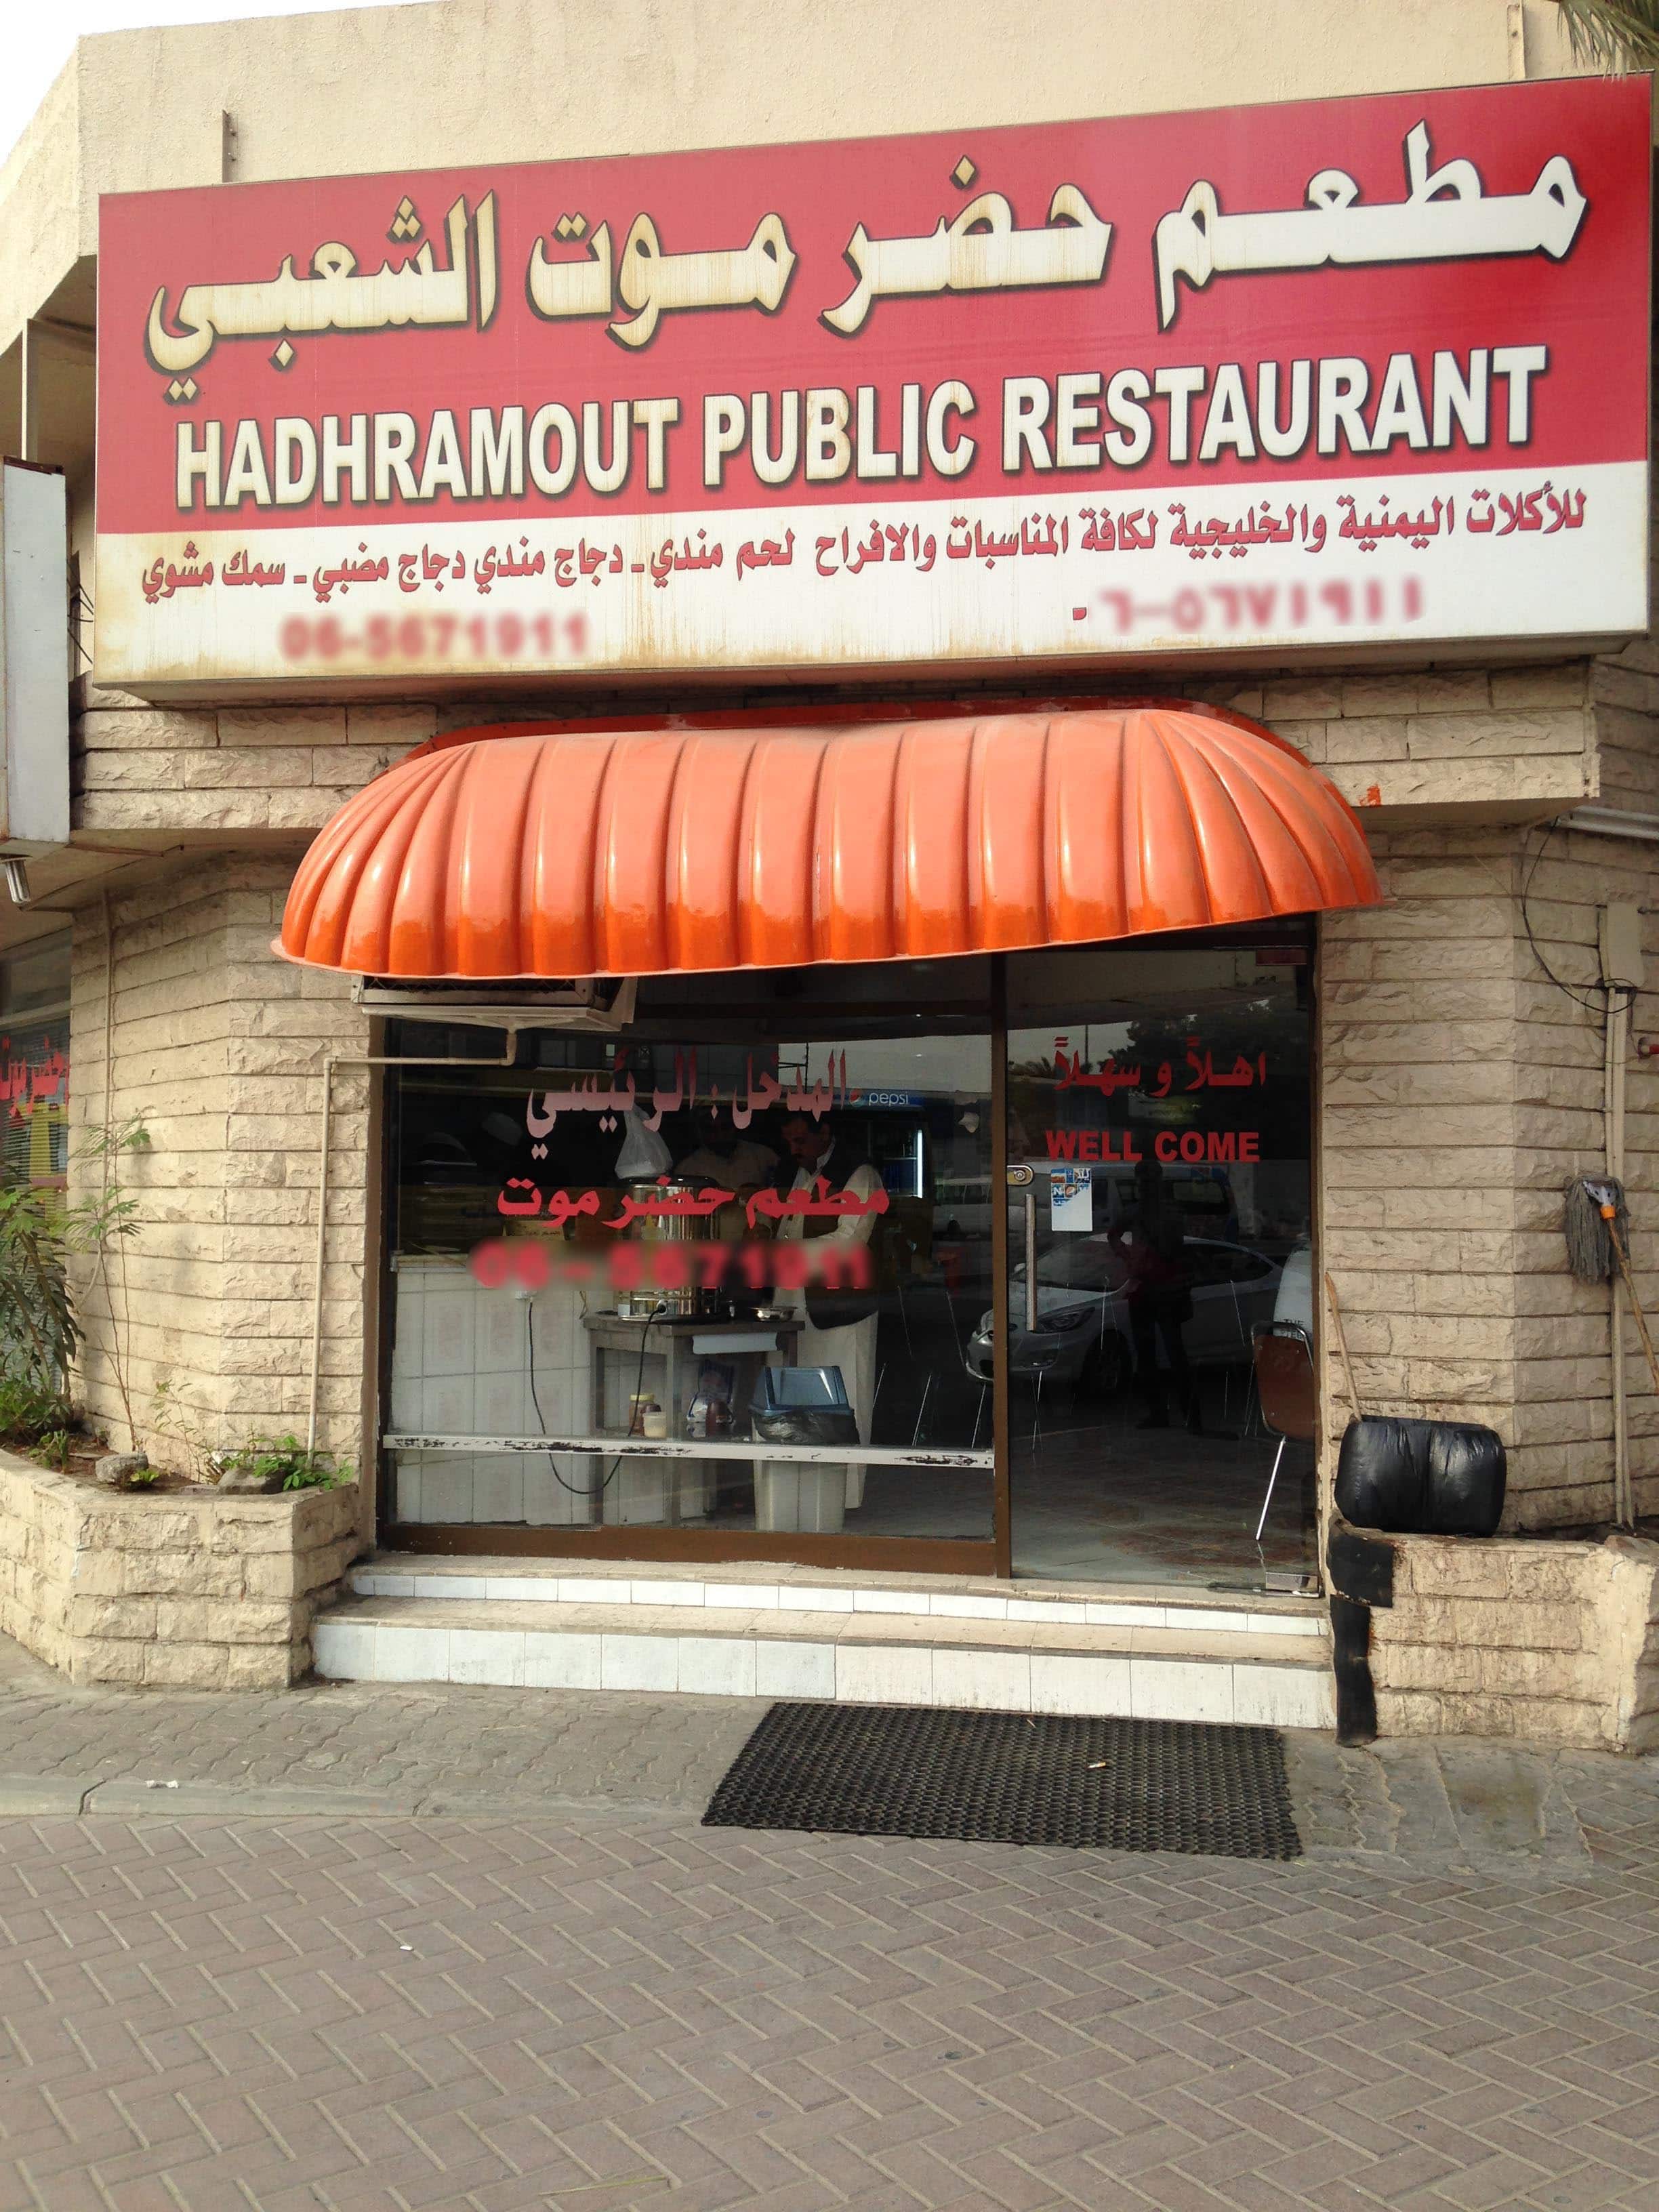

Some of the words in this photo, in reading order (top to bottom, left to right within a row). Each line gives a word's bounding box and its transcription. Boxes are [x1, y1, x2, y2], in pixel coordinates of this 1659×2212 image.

[1158, 119, 1587, 329] مطعم
[146, 189, 495, 401] الشعبي
[175, 396, 680, 510] HADHRAMOUT
[703, 380, 976, 487] PUBLIC
[1003, 345, 1548, 470] RESTAURANT
[1080, 509, 1158, 552] لكافة
[1169, 503, 1326, 559] والخليجية
[1338, 496, 1454, 552] اليمنية
[1467, 485, 1586, 535] للأكلات
[474, 537, 545, 594] مندي
[555, 541, 623, 588] دجاج
[737, 530, 794, 579] لحم
[816, 520, 936, 577] والافراح
[946, 514, 1068, 569] المناسبات
[142, 541, 213, 603] مشوي
[222, 552, 285, 587] سمك
[312, 544, 389, 603] مضبي
[399, 546, 466, 594] دجاج
[868, 1091, 909, 1105] pepsi
[1045, 1130, 1143, 1162] WELL
[1154, 1131, 1261, 1164] COME
[746, 1175, 890, 1229] مطعم
